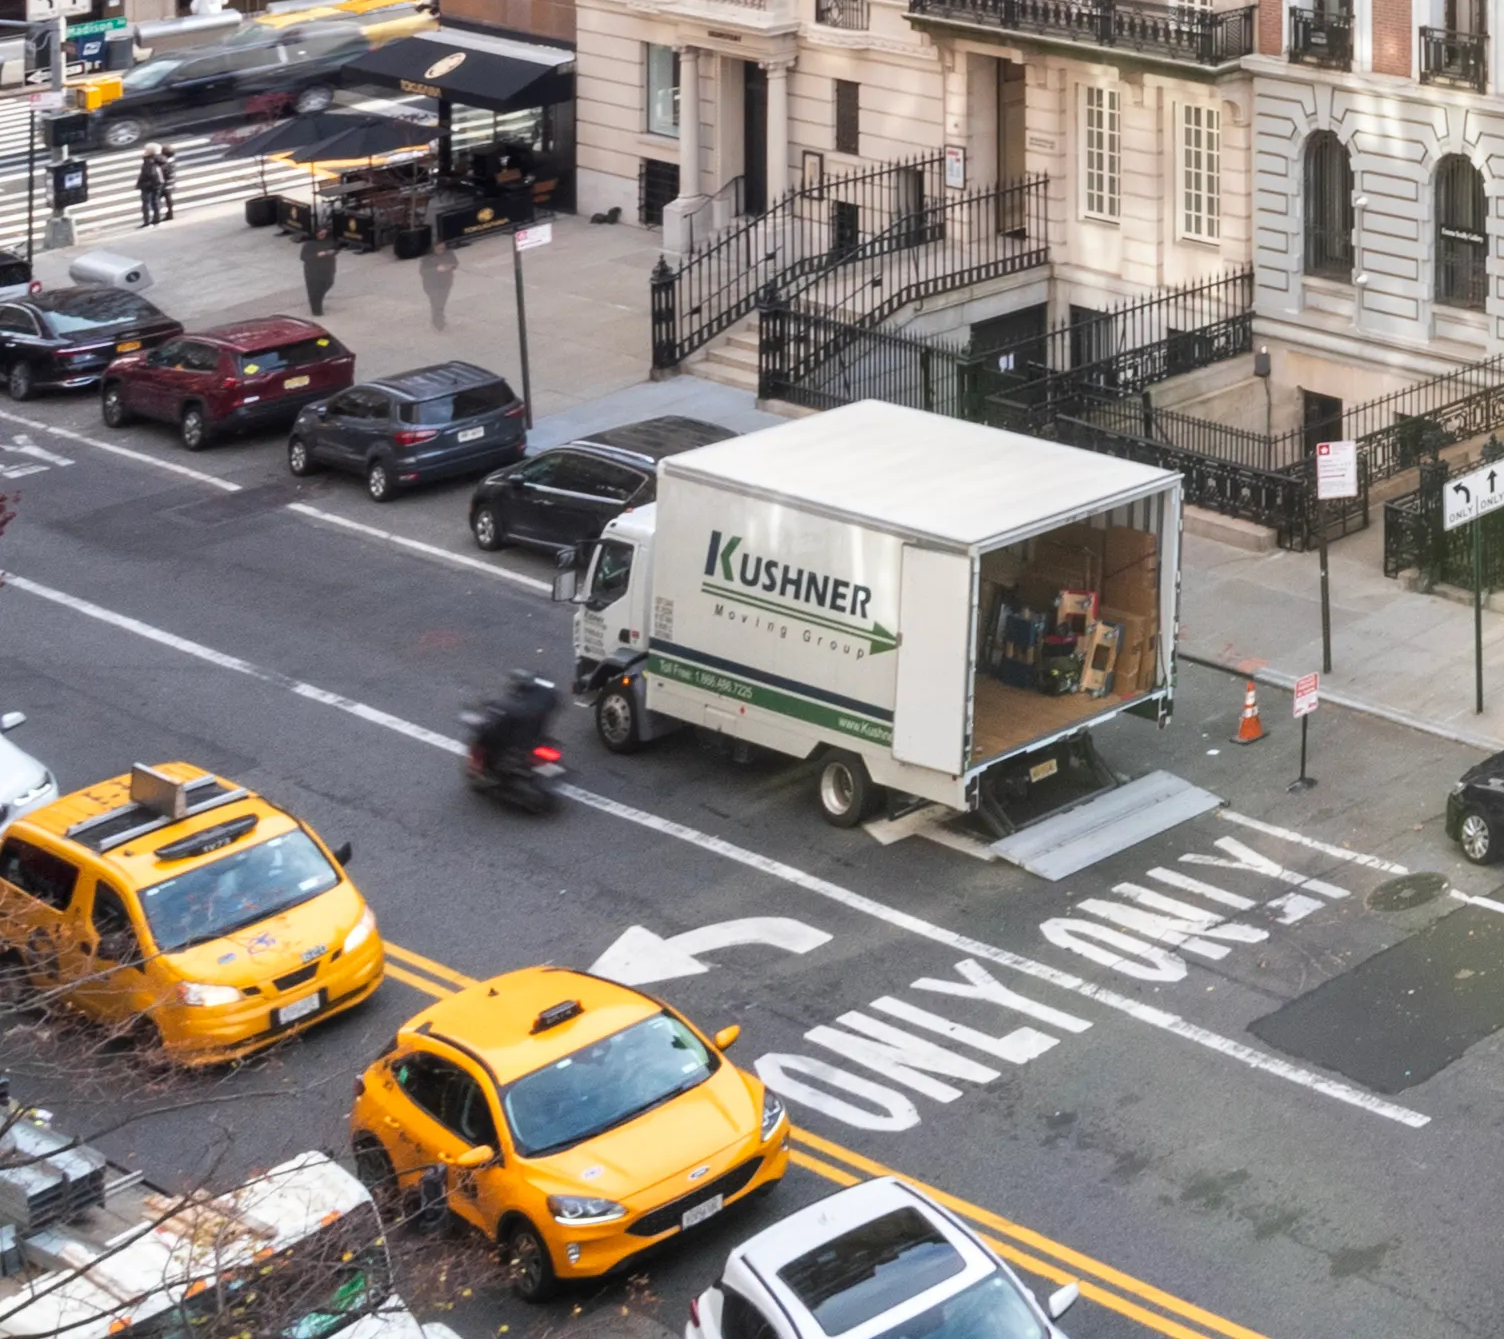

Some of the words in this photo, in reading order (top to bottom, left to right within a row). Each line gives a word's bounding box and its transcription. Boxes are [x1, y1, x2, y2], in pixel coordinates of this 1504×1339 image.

[1449, 505, 1473, 523] ONLY
[1480, 492, 1504, 510] ONLY
[704, 530, 872, 619] KUSHNER
[712, 603, 788, 640] Moving
[802, 630, 866, 660] Group
[659, 659, 672, 673] Toll
[673, 662, 692, 680] Free:
[1039, 835, 1351, 983] ONLY
[755, 958, 1093, 1132] ONLY
